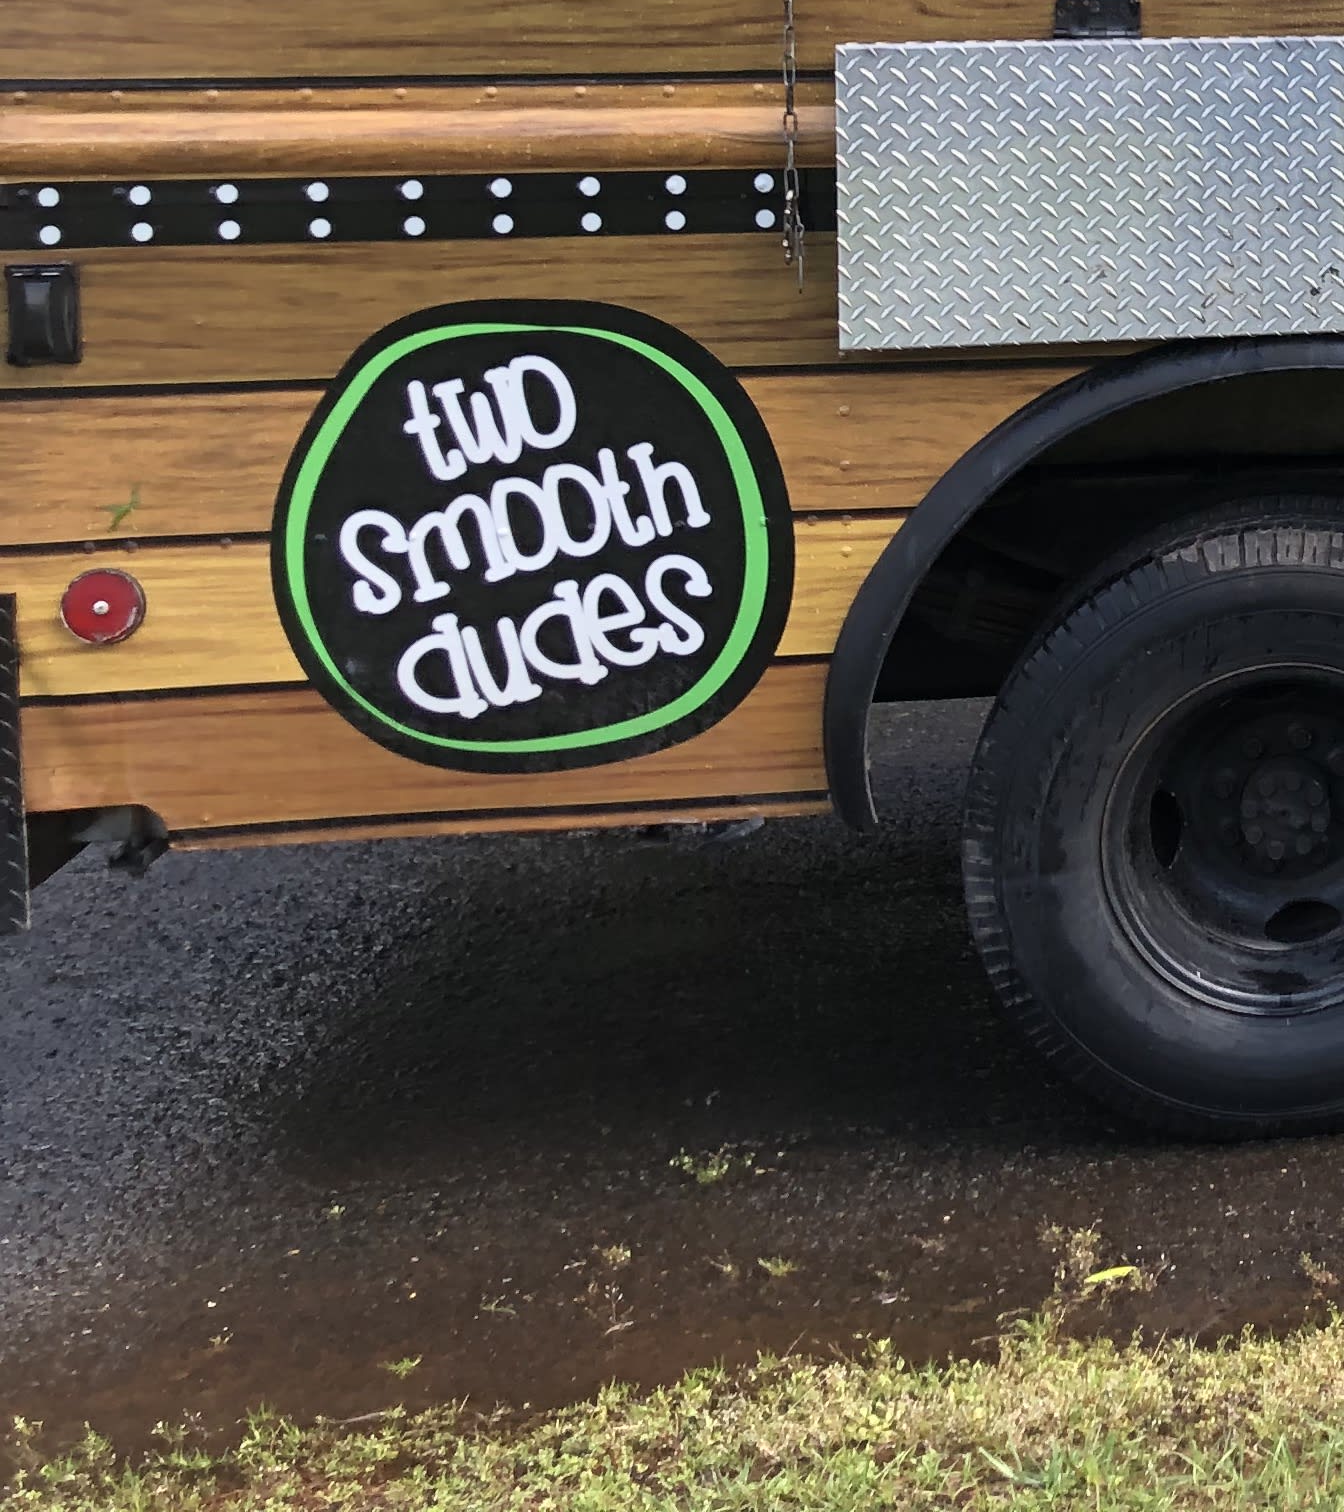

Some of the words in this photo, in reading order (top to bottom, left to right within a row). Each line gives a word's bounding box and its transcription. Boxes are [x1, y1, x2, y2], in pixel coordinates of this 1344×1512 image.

[403, 354, 578, 481] two
[339, 441, 712, 616] smooth
[396, 553, 713, 720] dudes
